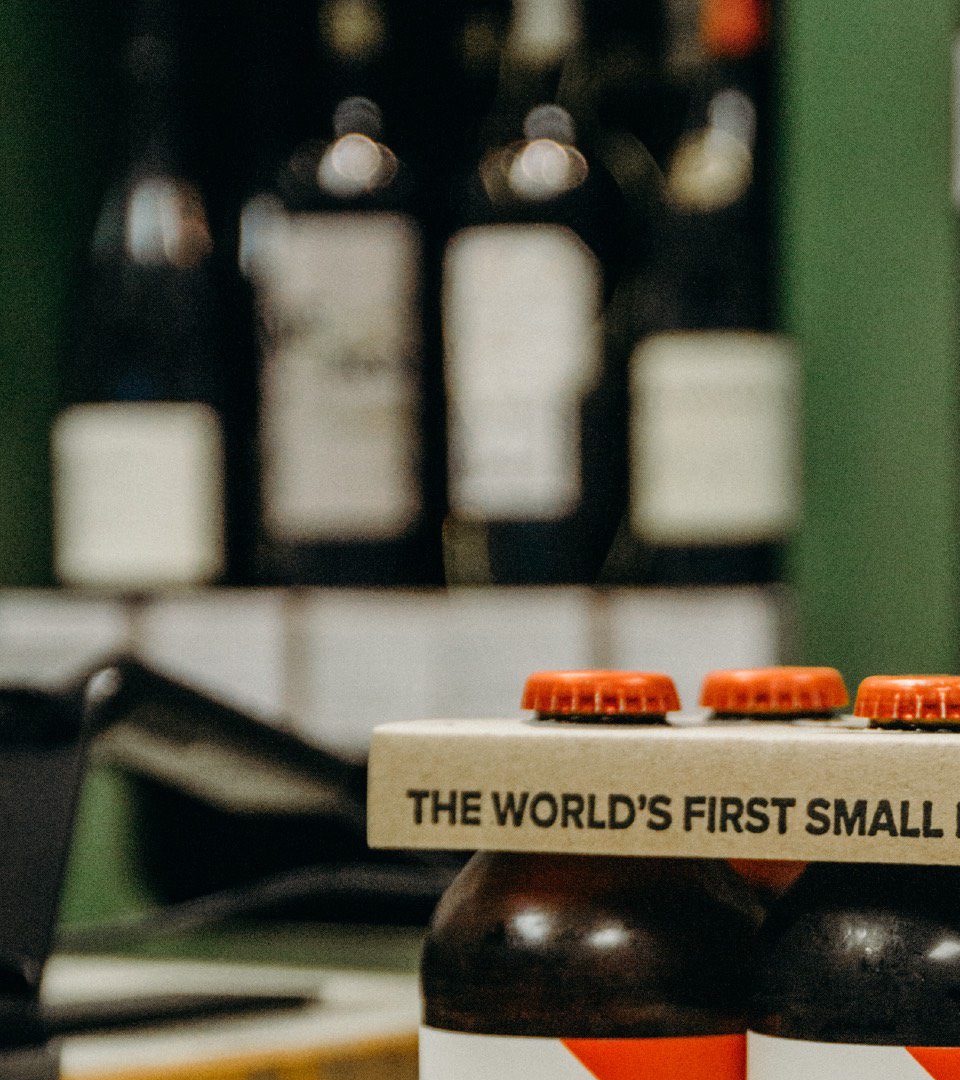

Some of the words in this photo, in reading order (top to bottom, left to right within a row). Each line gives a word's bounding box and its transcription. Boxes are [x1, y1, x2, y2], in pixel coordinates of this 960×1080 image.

[405, 788, 483, 827] THE
[491, 791, 673, 832] WORLD'S
[683, 795, 797, 836] FIRST
[804, 797, 945, 839] SMALL
